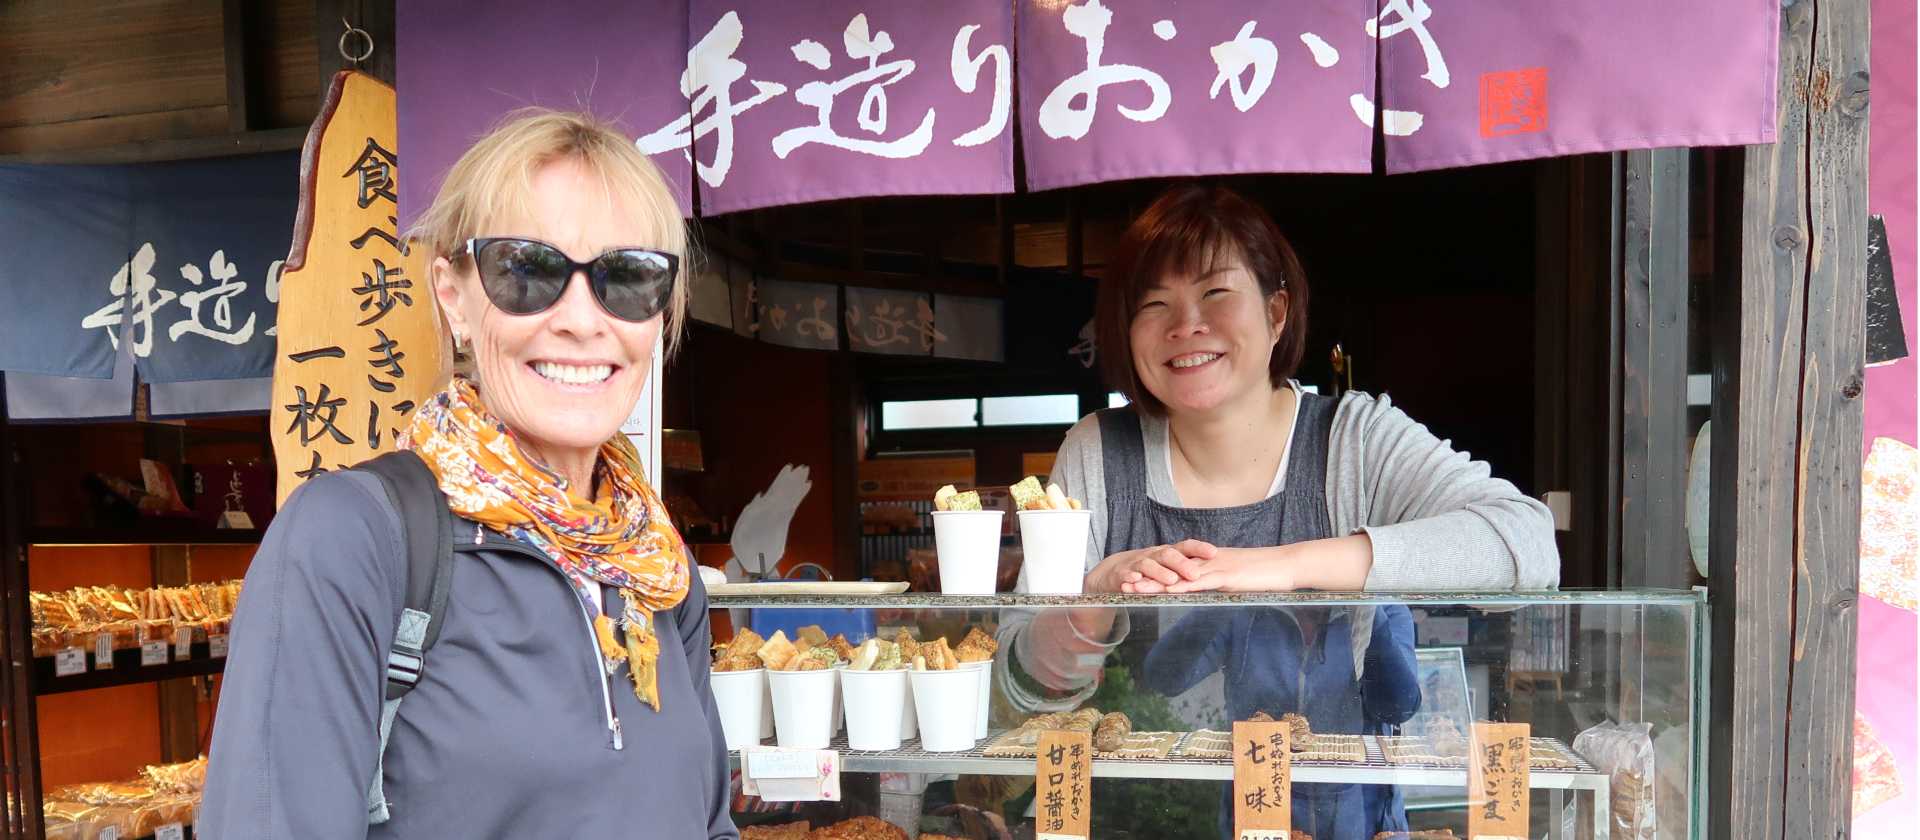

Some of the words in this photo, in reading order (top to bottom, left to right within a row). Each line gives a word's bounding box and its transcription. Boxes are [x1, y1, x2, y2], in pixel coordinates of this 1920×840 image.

[636, 0, 1450, 188] 手造りおかき
[342, 137, 415, 450] 食べ歩きに
[1244, 740, 1272, 813] 七味
